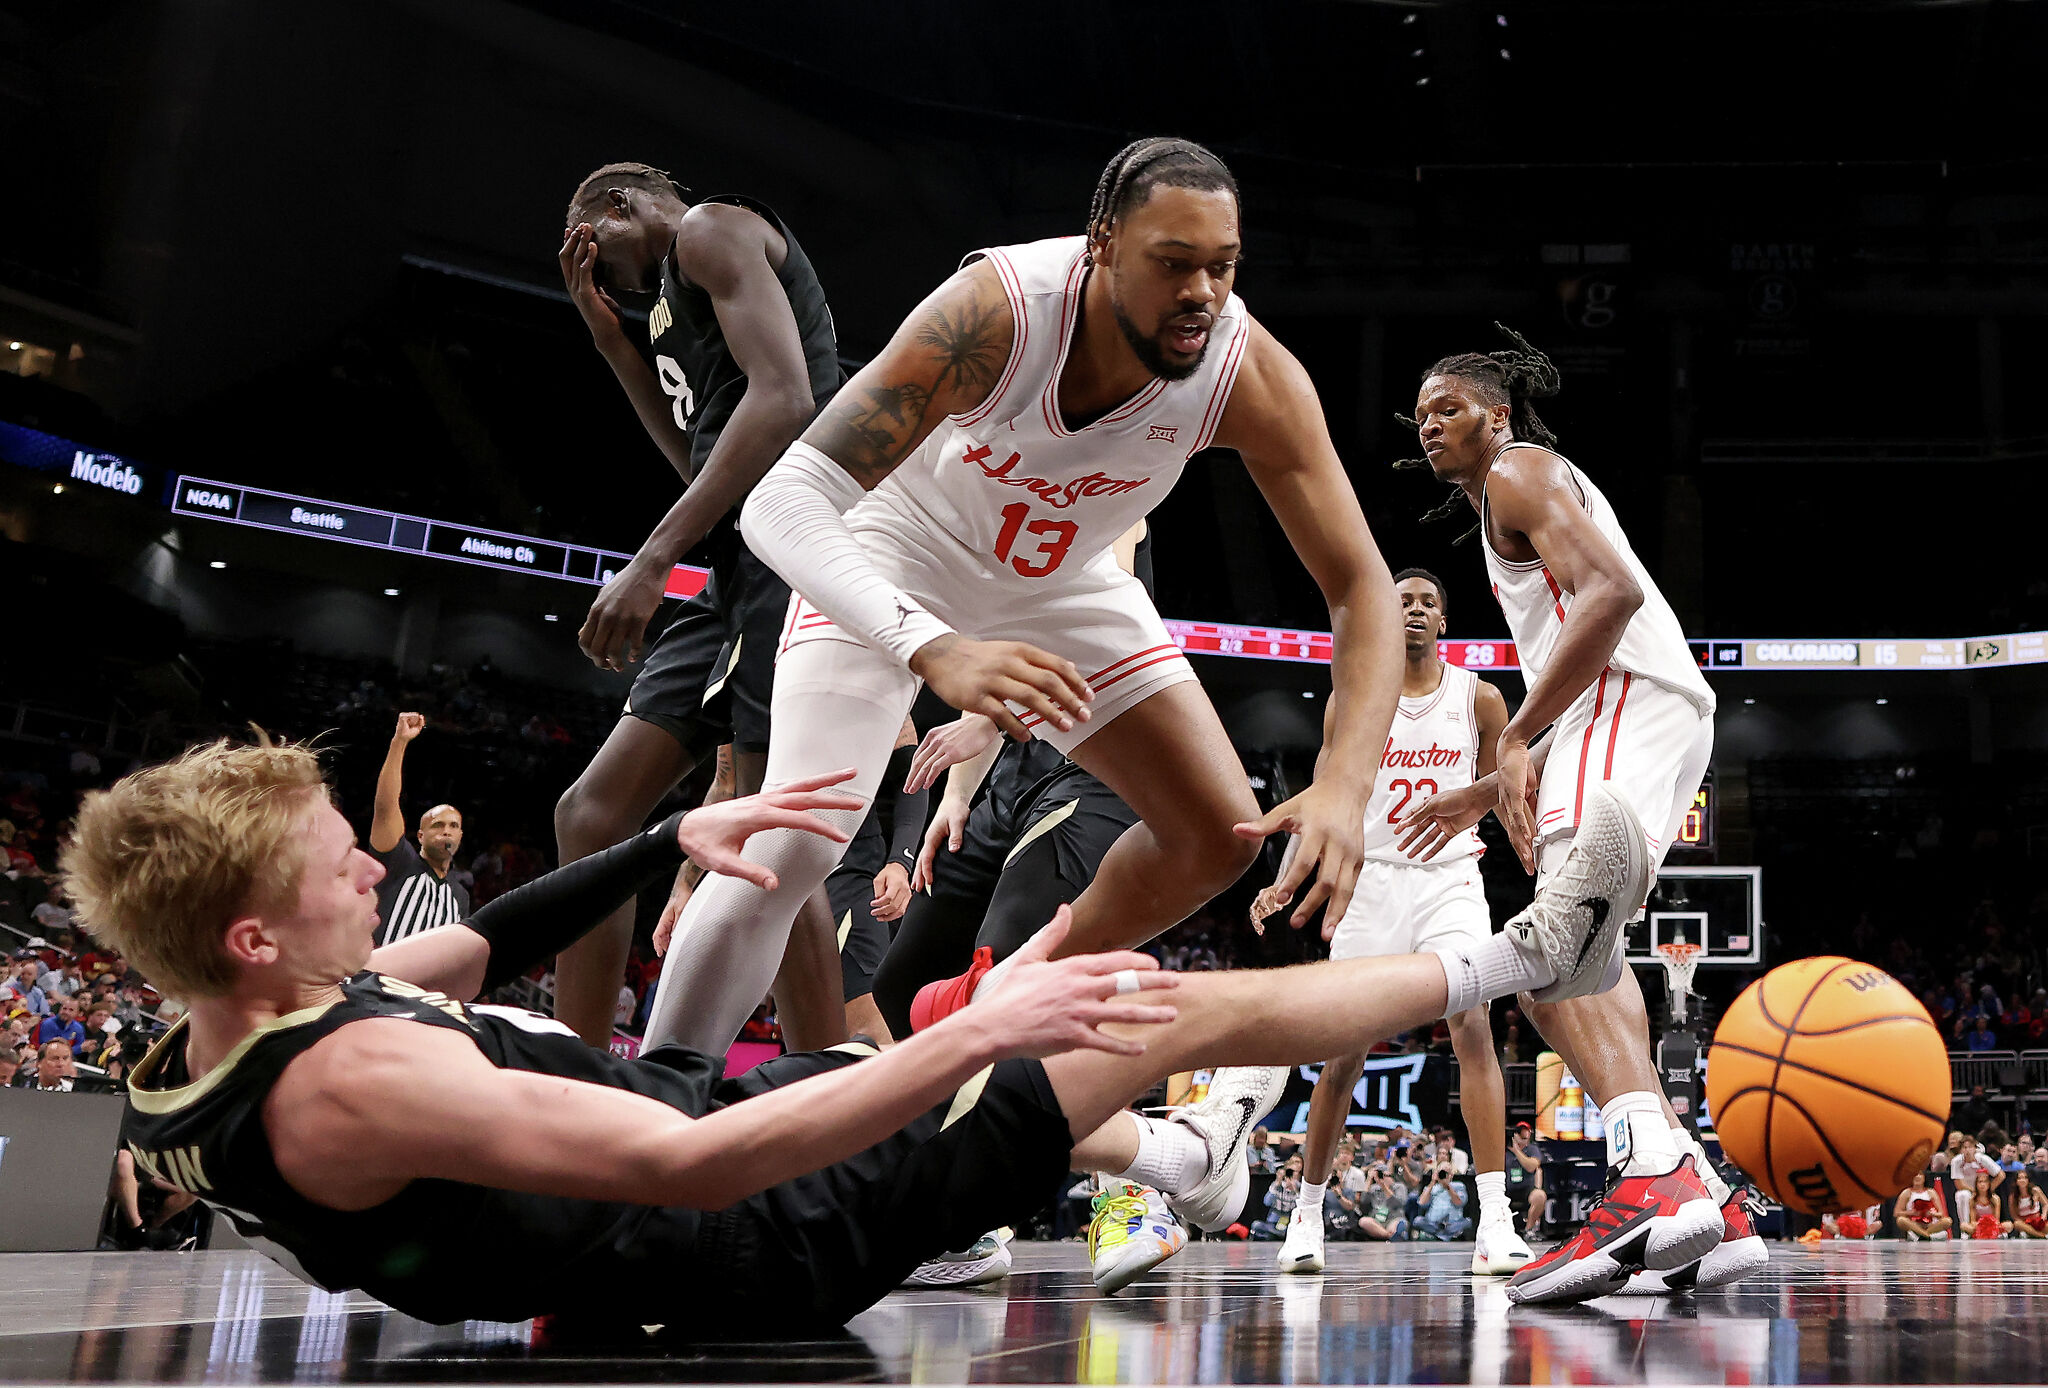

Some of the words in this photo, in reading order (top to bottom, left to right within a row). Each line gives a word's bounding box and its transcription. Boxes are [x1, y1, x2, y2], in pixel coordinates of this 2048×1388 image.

[656, 355, 695, 431] 8
[71, 450, 143, 495] Modelo
[186, 488, 232, 510] NCAA
[290, 507, 346, 531] Seattle
[461, 537, 513, 559] Abilene
[514, 546, 536, 563] Ch
[994, 501, 1080, 578] 13
[1464, 644, 1496, 666] 26
[1756, 643, 1858, 661] COLORADO
[1690, 791, 1707, 808] 4
[1675, 809, 1701, 842] 0
